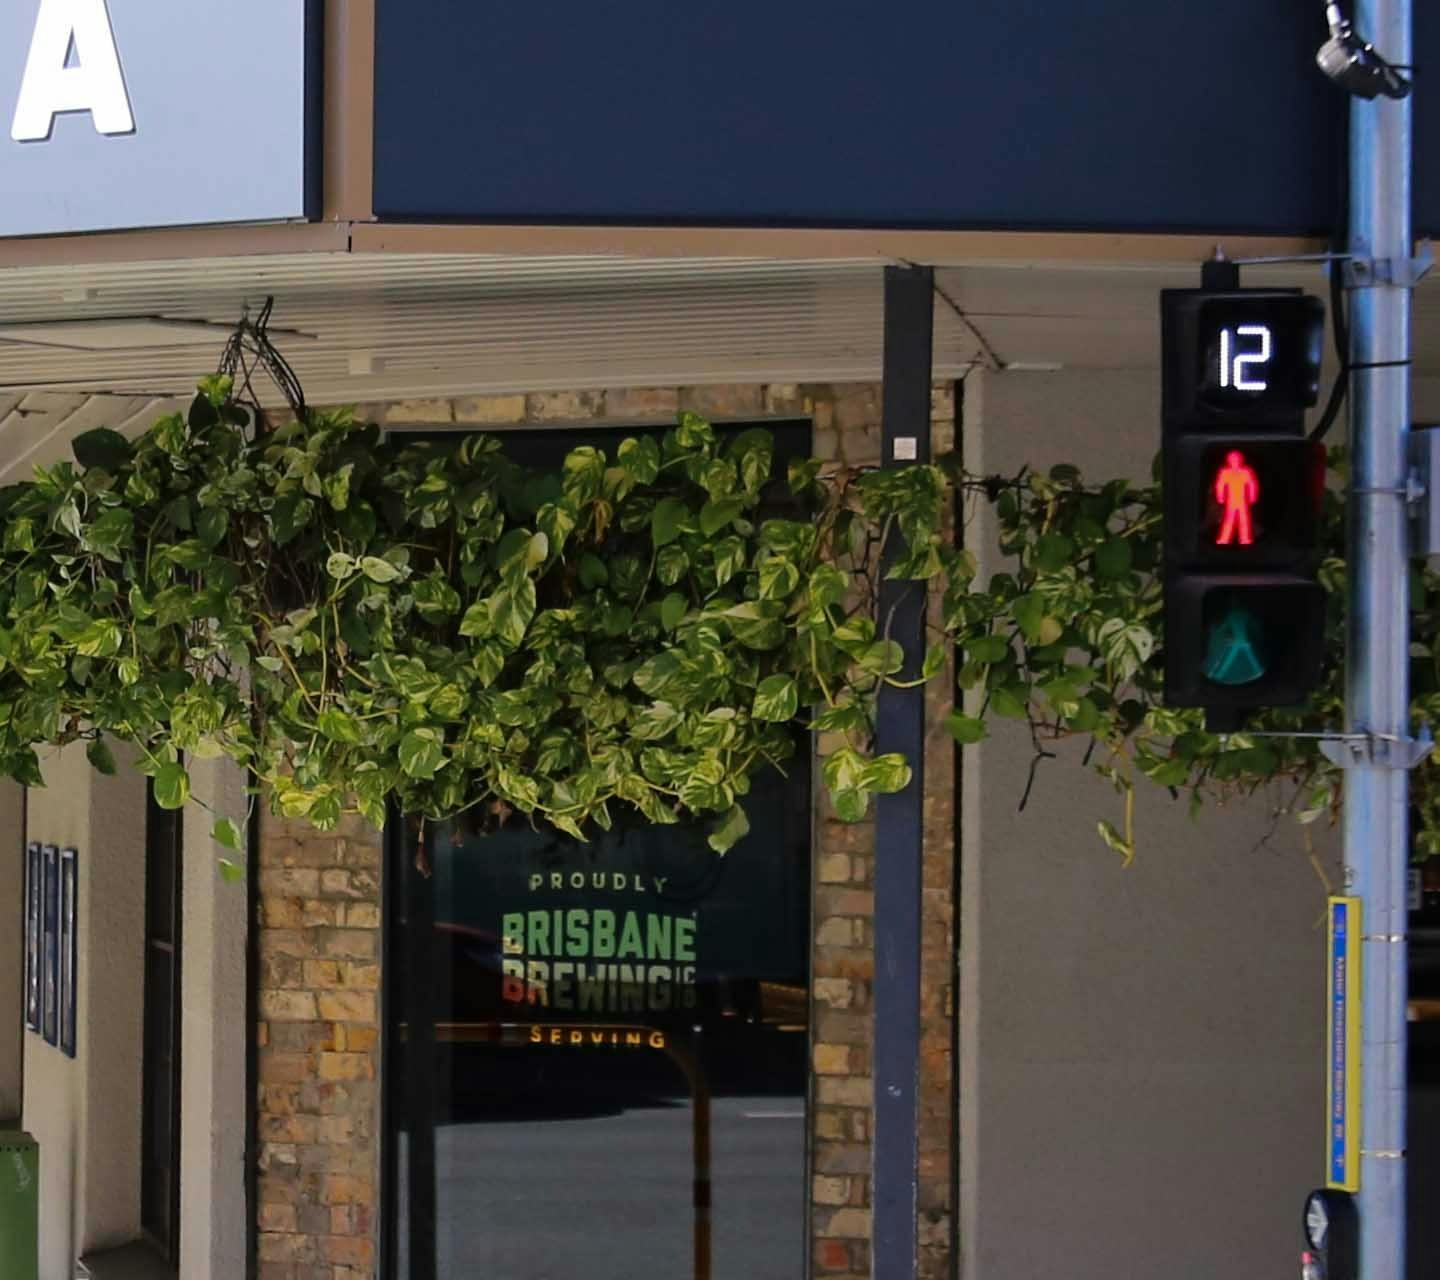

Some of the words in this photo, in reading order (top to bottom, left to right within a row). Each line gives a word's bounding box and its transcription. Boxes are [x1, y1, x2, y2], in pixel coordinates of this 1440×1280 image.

[1218, 325, 1272, 391] 12
[529, 872, 668, 893] PROUDLY
[502, 909, 697, 962] BRISBANE
[502, 959, 672, 1011] BREWING
[530, 1024, 666, 1049] SERVING
